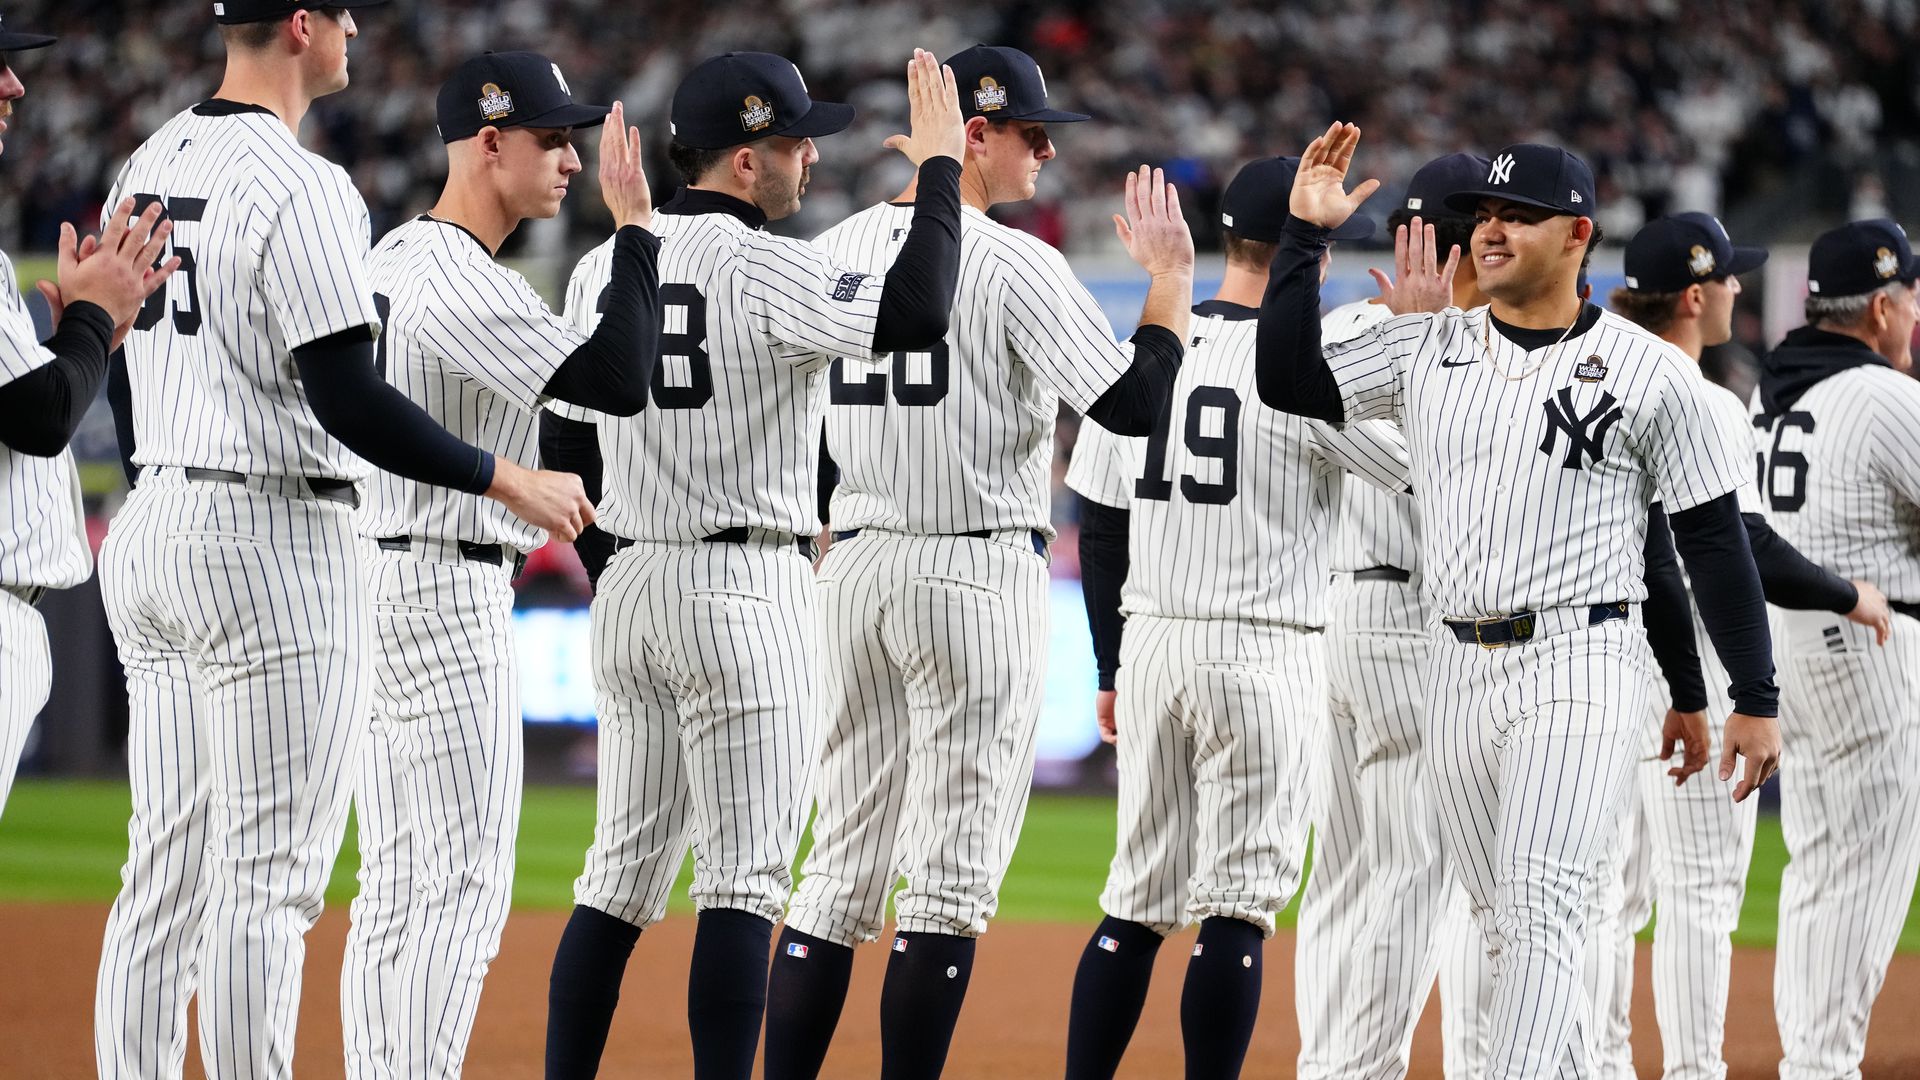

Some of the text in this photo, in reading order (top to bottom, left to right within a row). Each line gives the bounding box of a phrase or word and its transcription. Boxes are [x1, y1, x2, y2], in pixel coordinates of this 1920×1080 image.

[976, 89, 1005, 100] WORLD
[978, 96, 1005, 106] SERIES
[480, 95, 510, 109] WORLD
[483, 101, 511, 115] SERIES
[742, 106, 771, 120] WORLD
[745, 112, 772, 127] SERIES
[1487, 153, 1516, 185] NY
[1577, 369, 1603, 378] SERIES
[1578, 364, 1606, 375] WORLD
[1538, 385, 1624, 470] NY
[1135, 385, 1242, 505] 19
[1512, 617, 1531, 637] 89
